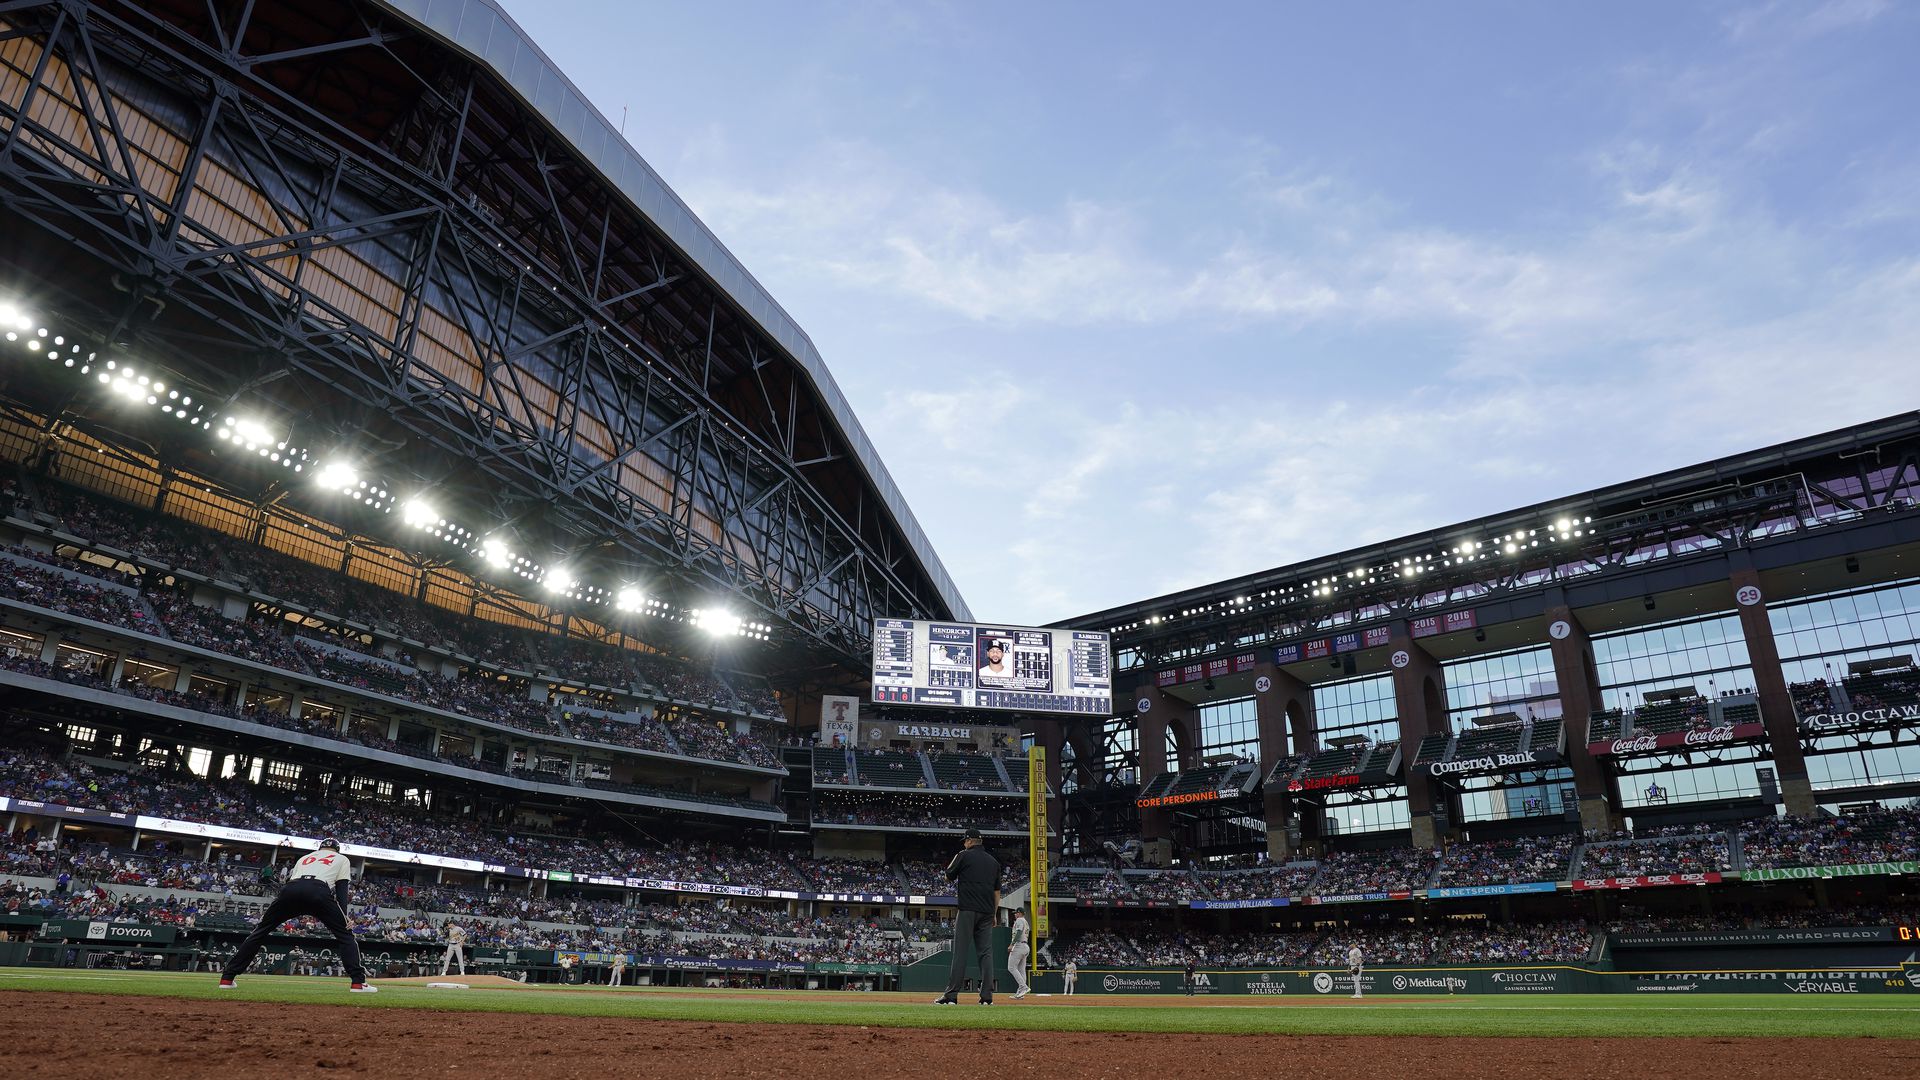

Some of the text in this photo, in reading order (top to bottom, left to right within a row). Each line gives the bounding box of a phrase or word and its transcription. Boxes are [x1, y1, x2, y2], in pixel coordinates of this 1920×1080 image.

[1740, 589, 1758, 602] 29
[1447, 611, 1469, 622] 2016
[1414, 618, 1435, 629] 2015
[1367, 627, 1387, 638] 2012
[1307, 640, 1326, 650] 2011
[1337, 634, 1355, 645] 2011
[1278, 646, 1297, 656] 2010
[1209, 660, 1228, 670] 1999
[1394, 653, 1408, 666] 26
[1257, 678, 1270, 691] 34
[1815, 704, 1919, 727] CHOCTAW
[826, 722, 853, 731] TEXAS
[898, 725, 970, 739] KARBACH
[1684, 724, 1735, 744] Coca-Cola
[1611, 735, 1658, 754] Coca-Cola
[1497, 750, 1537, 766] Bank
[1137, 791, 1219, 808] CORE PERSONNEL
[1037, 818, 1045, 847] THE
[1038, 850, 1046, 893] HEAT
[1757, 860, 1915, 882] LUXOR STAFFING
[1616, 878, 1639, 886] DEX
[1648, 876, 1671, 884] DEX
[1681, 873, 1706, 882] DEX
[1451, 886, 1506, 897] NETSPEND
[1322, 894, 1364, 904] GARDENERS
[1365, 892, 1388, 901] TRUST
[110, 927, 153, 938] TOYOTA
[1777, 932, 1823, 940] AHEAD
[1832, 931, 1880, 939] READY
[663, 957, 718, 968] Germania
[1498, 972, 1557, 982] CHOCTAW
